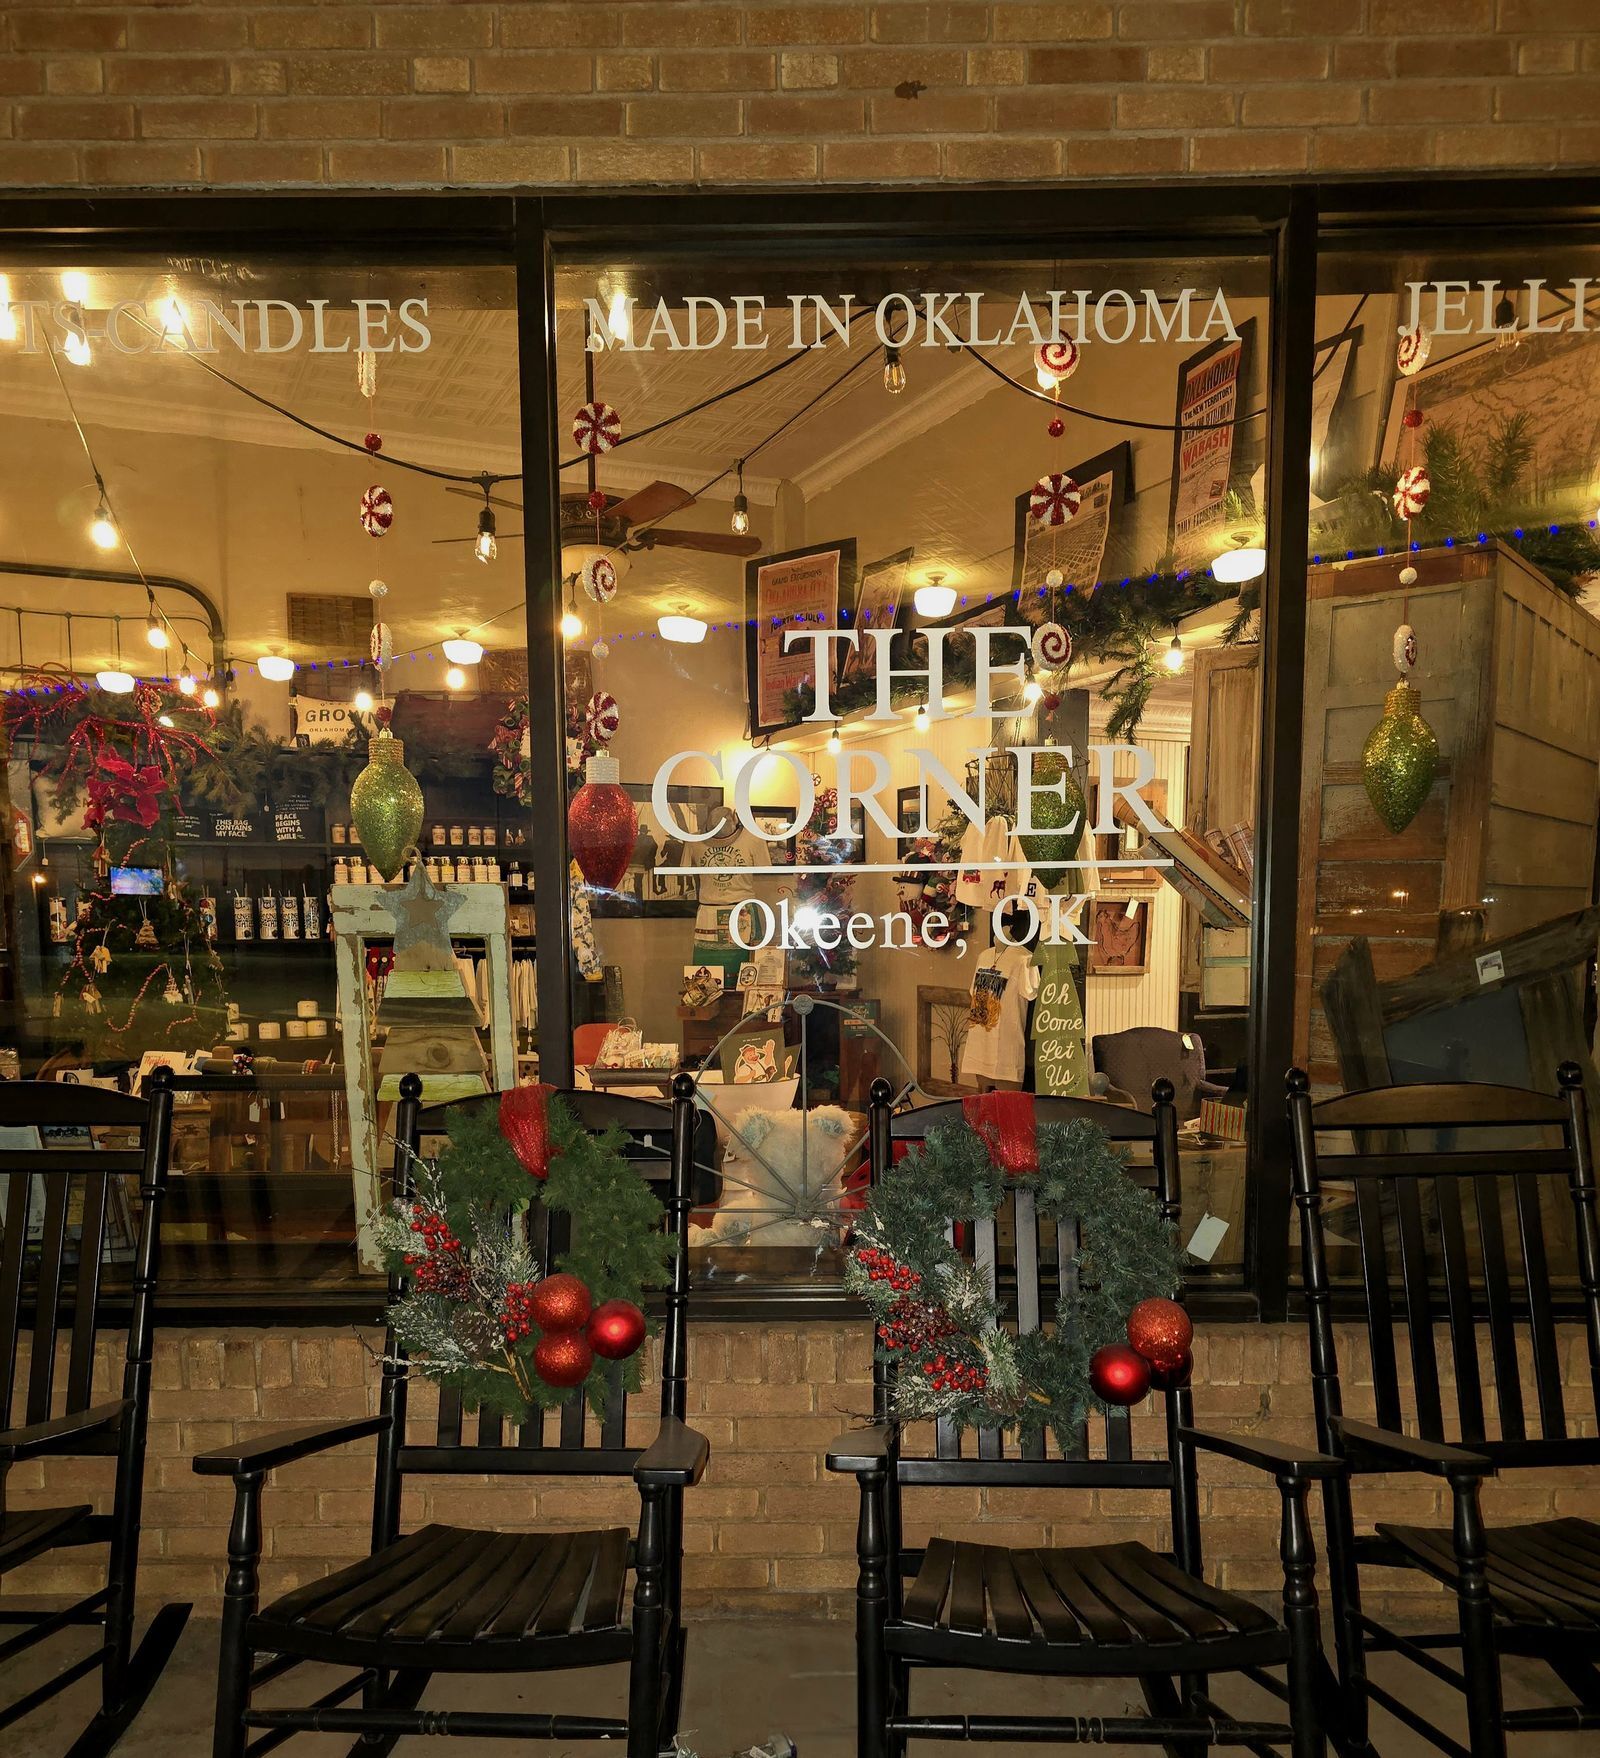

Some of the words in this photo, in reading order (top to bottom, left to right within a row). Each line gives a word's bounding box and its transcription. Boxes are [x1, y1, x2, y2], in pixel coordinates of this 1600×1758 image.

[583, 296, 769, 351] MADE
[786, 294, 856, 349] IN
[875, 286, 1242, 348] OKLAHOMA
[1397, 277, 1600, 336] JELLI
[1183, 353, 1237, 407] OKLAHOMA
[1193, 403, 1204, 416] NEW
[1204, 385, 1232, 409] TERRITORY
[1183, 425, 1229, 471] WABASH
[784, 626, 1034, 722] THE
[651, 744, 1176, 842] CORNER
[275, 813, 297, 821] PEACE
[277, 833, 297, 841] SMILE
[728, 898, 967, 959] Okeene,
[992, 893, 1098, 947] OK
[1041, 983, 1071, 1005] Oh
[1036, 1010, 1083, 1033] Come
[1039, 1040, 1074, 1062] Let
[1045, 1064, 1074, 1086] Us
